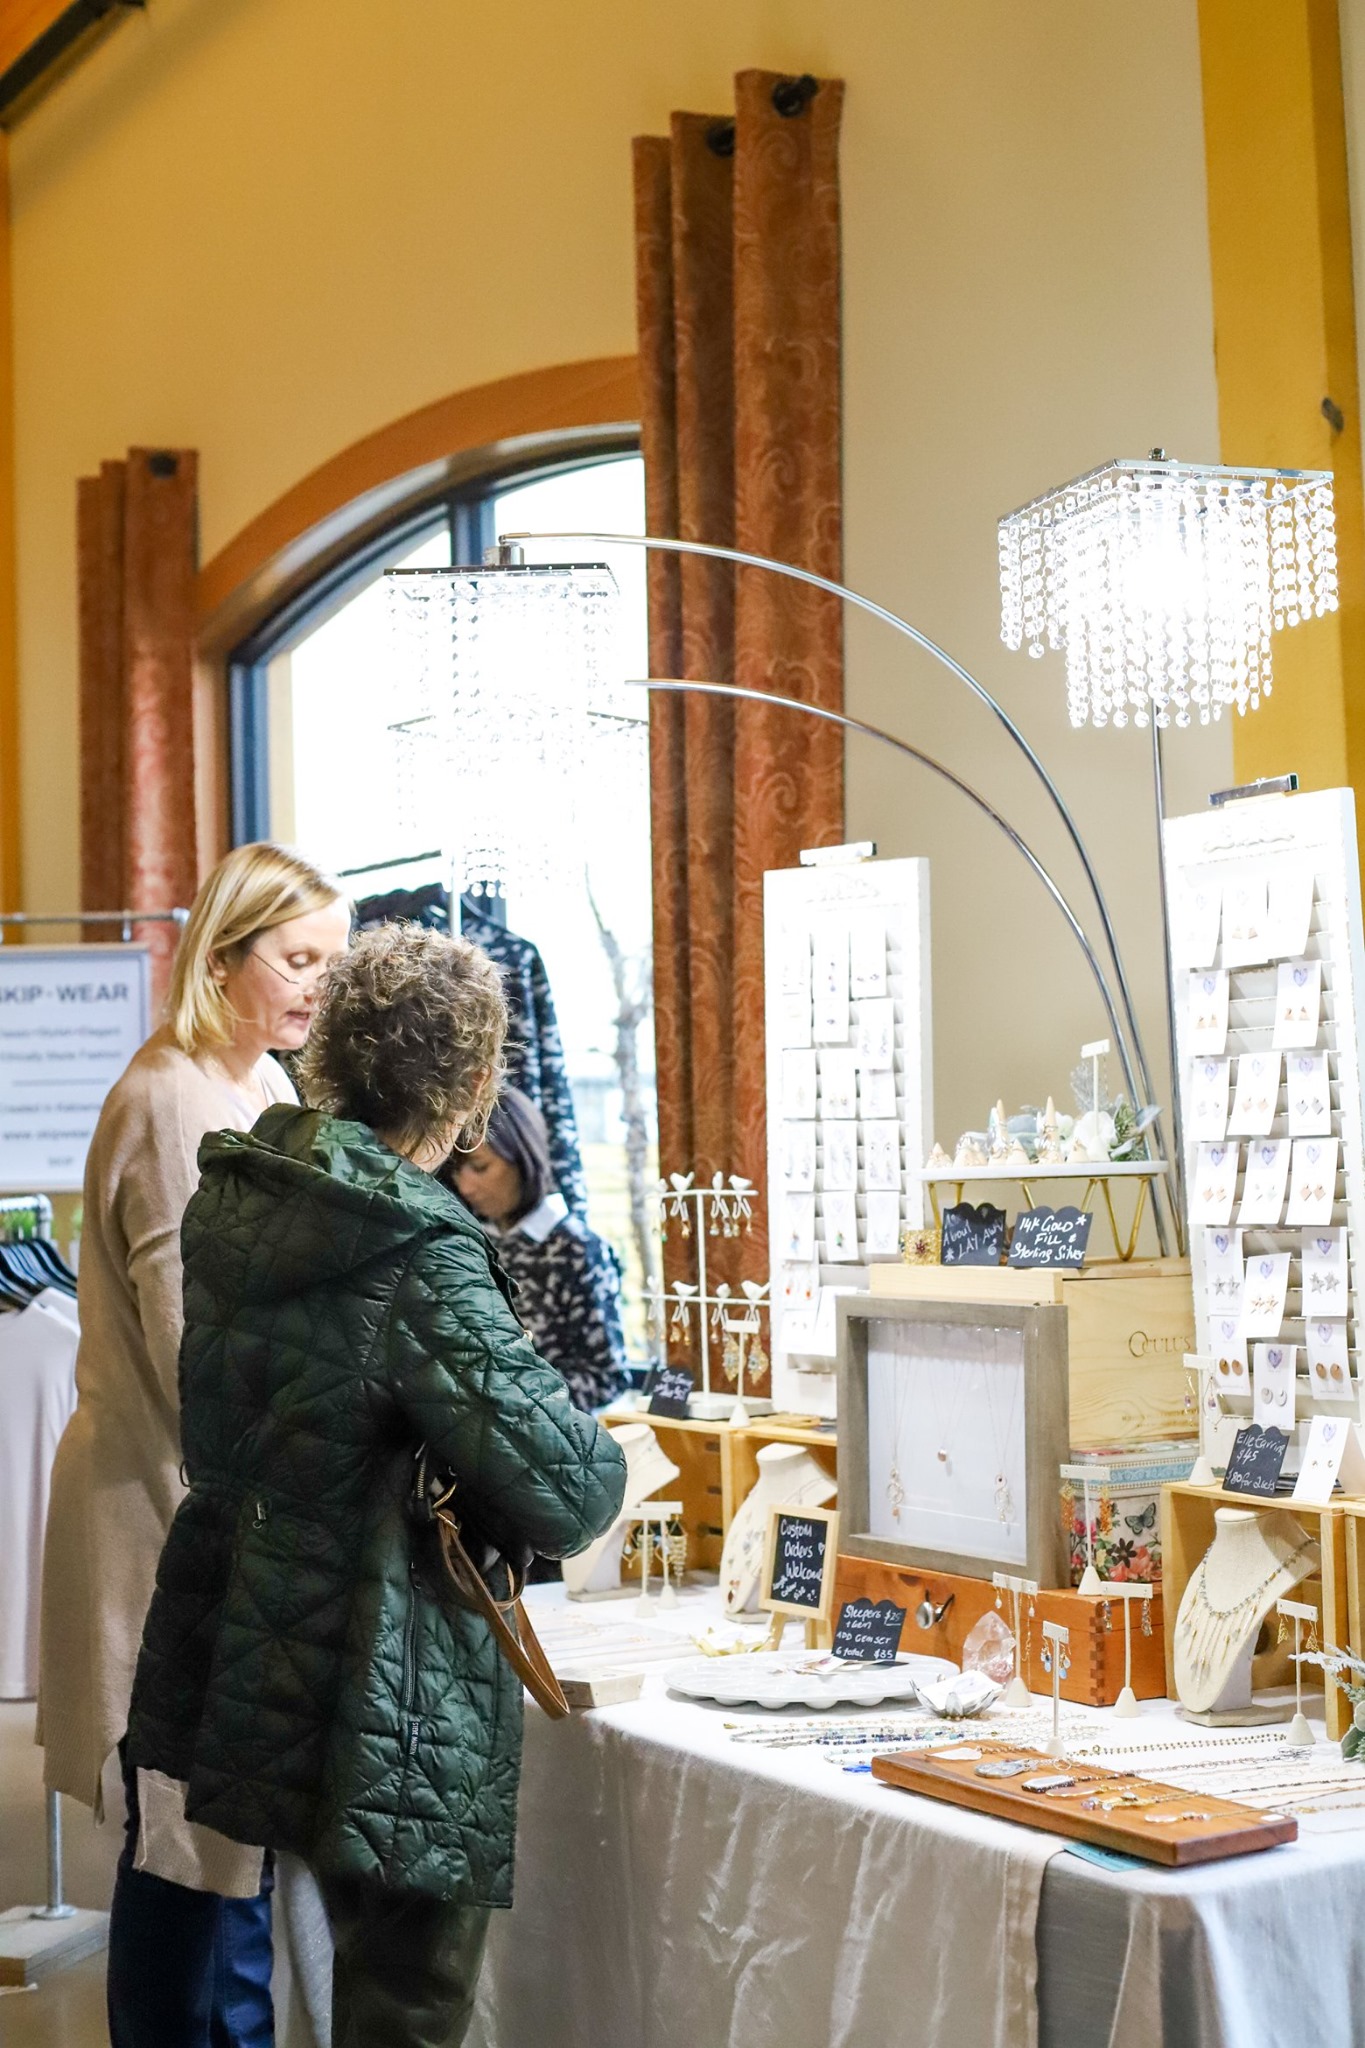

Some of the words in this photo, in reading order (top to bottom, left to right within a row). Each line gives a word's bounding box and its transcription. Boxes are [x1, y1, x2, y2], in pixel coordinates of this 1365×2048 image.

[1010, 1242, 1053, 1264] Sterling
[1054, 1245, 1086, 1260] Silver
[1236, 1447, 1260, 1465] $45
[784, 1541, 813, 1558] Orders
[786, 1561, 823, 1581] Welcome
[843, 1604, 882, 1621] Sleepers
